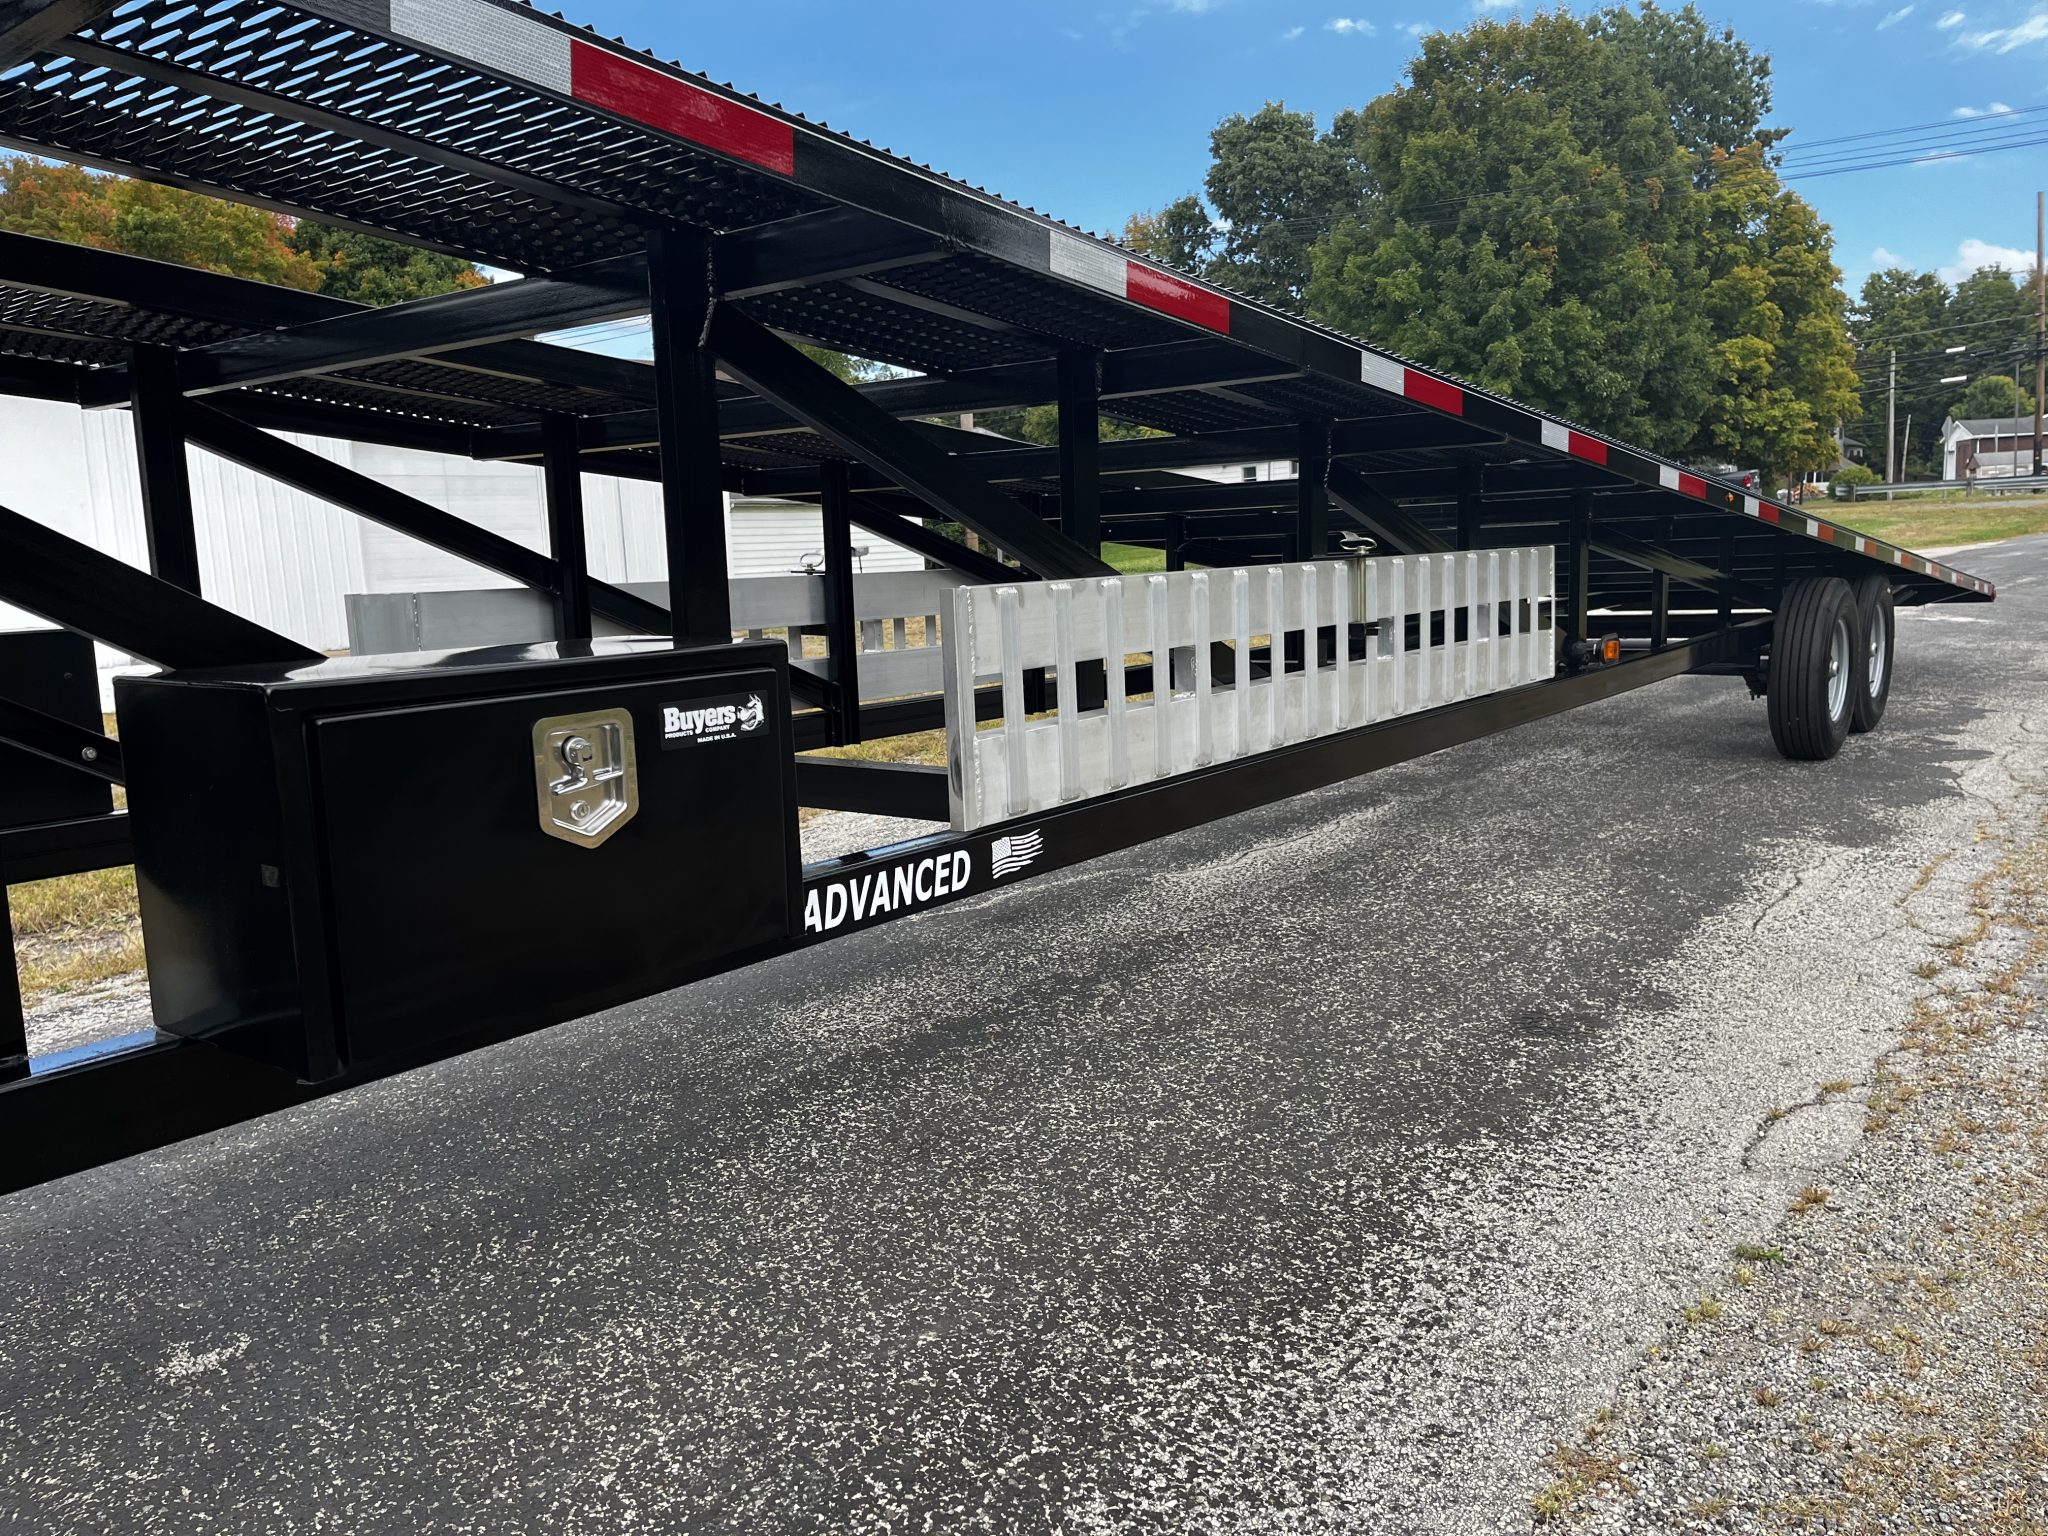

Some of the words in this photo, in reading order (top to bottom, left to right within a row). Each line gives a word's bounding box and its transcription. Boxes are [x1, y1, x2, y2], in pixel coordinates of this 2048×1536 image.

[663, 705, 736, 734] Buyers
[705, 724, 730, 733] COMPANY
[664, 730, 694, 739] PRODUCTS
[697, 735, 713, 743] MADE
[804, 850, 971, 933] ADVANCED
